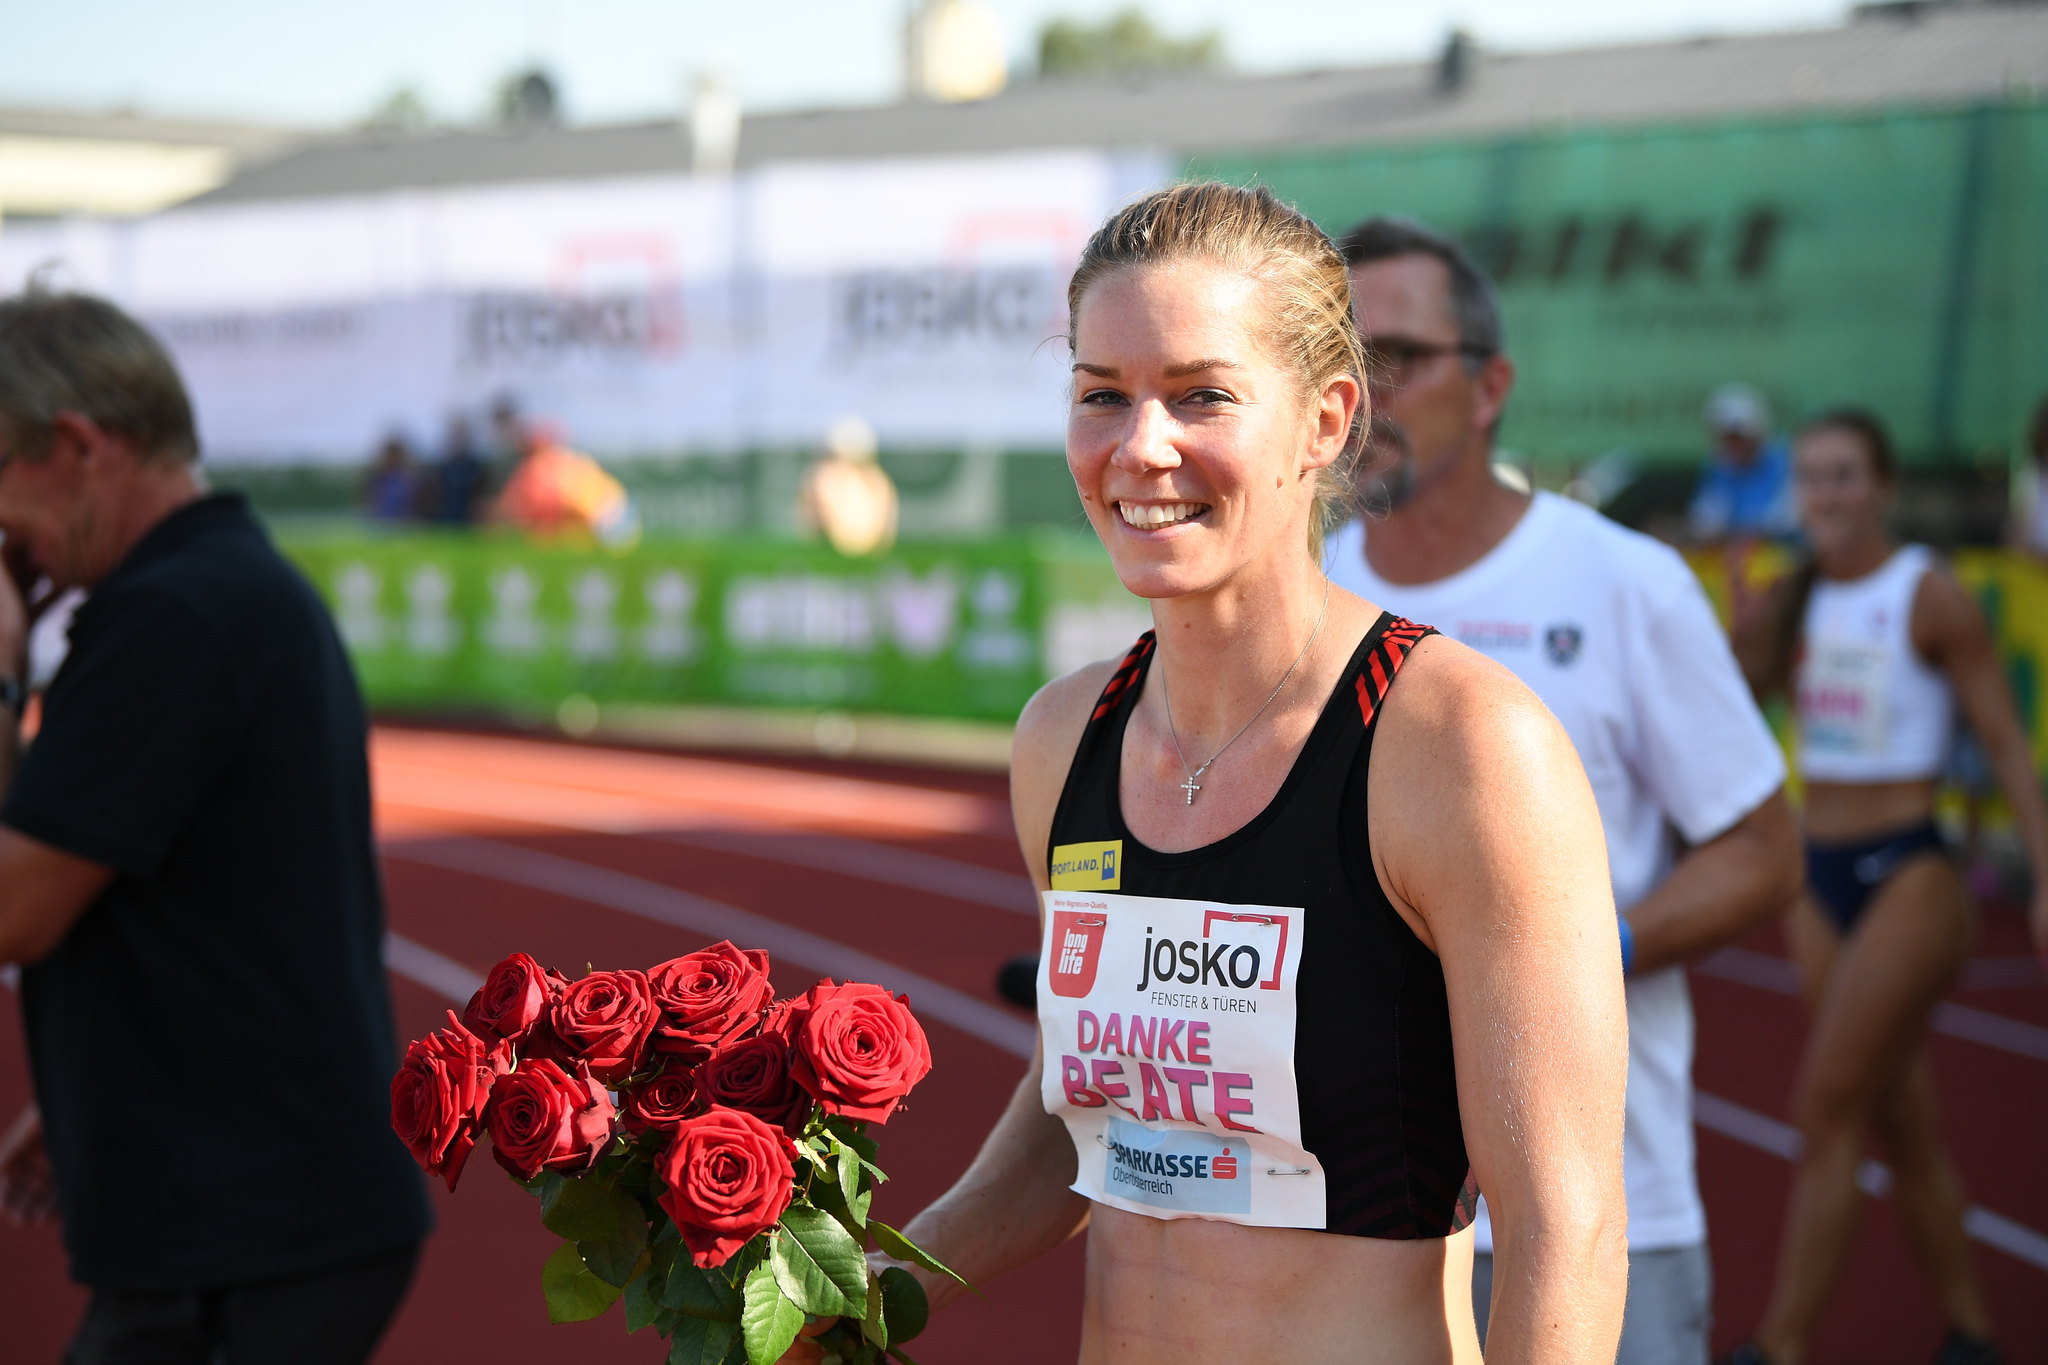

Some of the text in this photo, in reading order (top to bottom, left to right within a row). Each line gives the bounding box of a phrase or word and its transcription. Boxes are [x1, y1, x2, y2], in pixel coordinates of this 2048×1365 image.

[1063, 928, 1088, 953] long
[1058, 948, 1083, 975] life
[1151, 991, 1257, 1013] FENSTER & TÜREN
[1077, 1009, 1212, 1065] DANKE
[1061, 1054, 1265, 1135] BEATE
[1112, 1141, 1208, 1179] SPARKASSE
